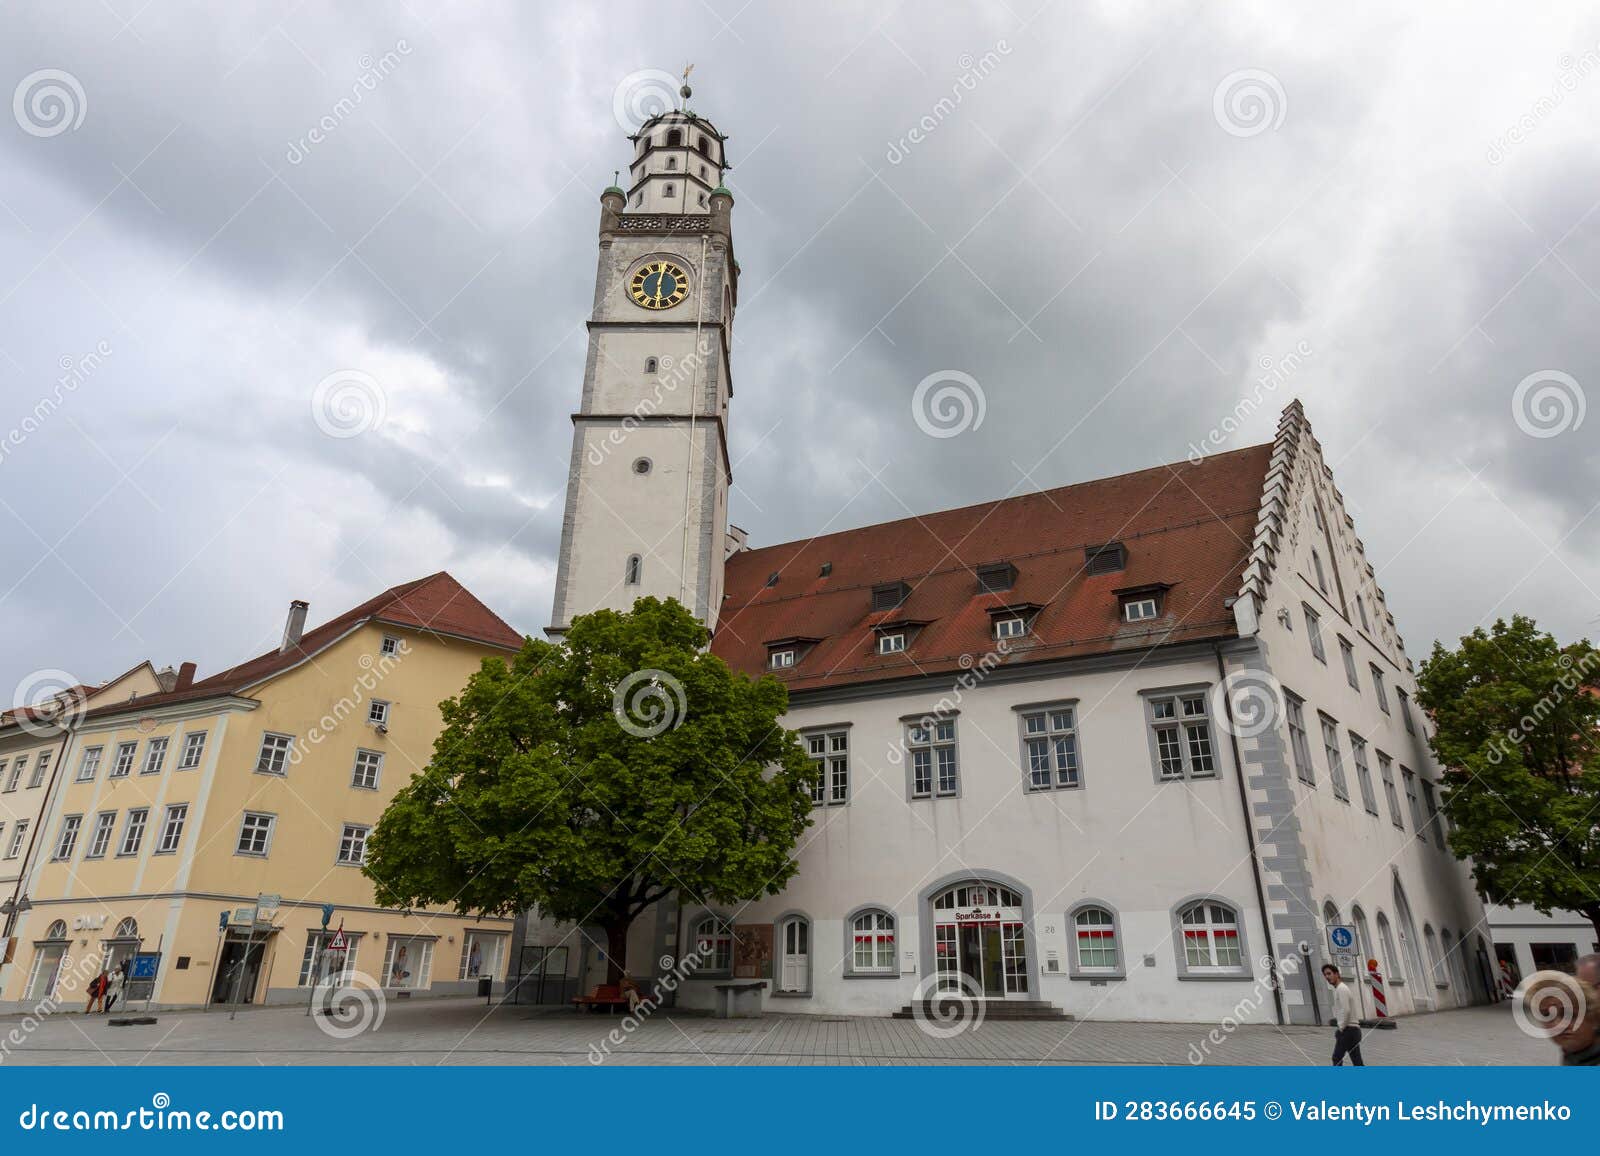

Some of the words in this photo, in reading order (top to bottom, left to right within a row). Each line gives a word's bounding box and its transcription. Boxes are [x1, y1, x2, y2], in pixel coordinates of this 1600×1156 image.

[955, 912, 991, 920] Sparkasse
[73, 915, 108, 930] ONLY
[1045, 926, 1055, 934] 28
